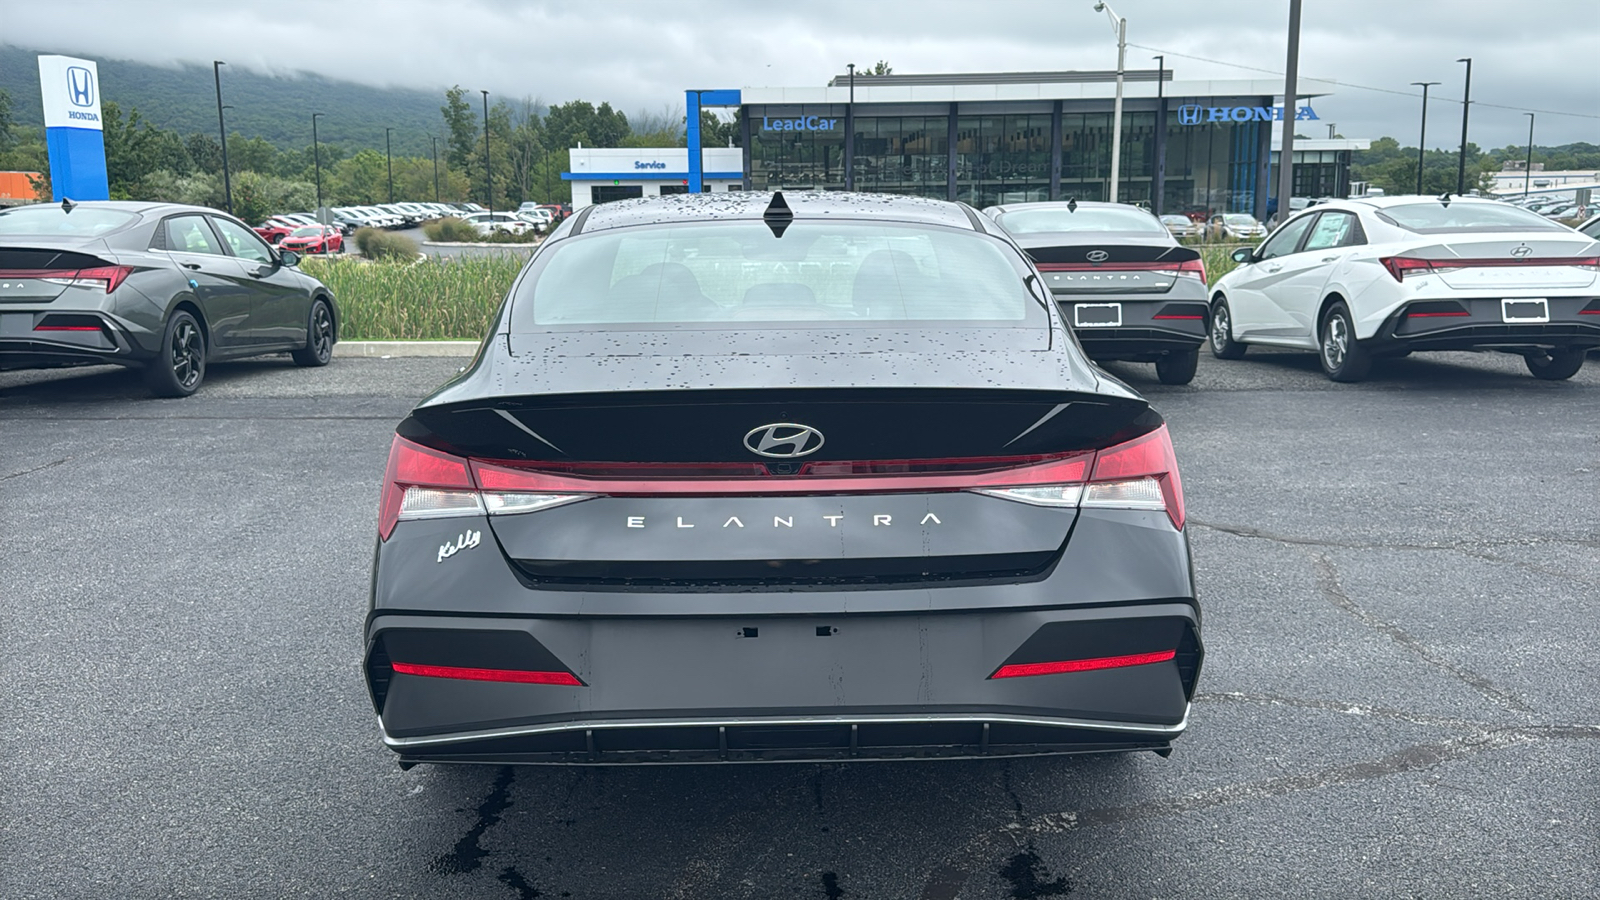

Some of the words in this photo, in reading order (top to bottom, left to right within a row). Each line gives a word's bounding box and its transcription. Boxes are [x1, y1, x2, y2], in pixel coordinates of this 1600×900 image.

[68, 111, 99, 122] HONDA
[763, 115, 837, 132] LeadCar
[634, 161, 667, 170] Service
[627, 512, 942, 528] ELANTRA
[437, 529, 481, 563] Kelly
